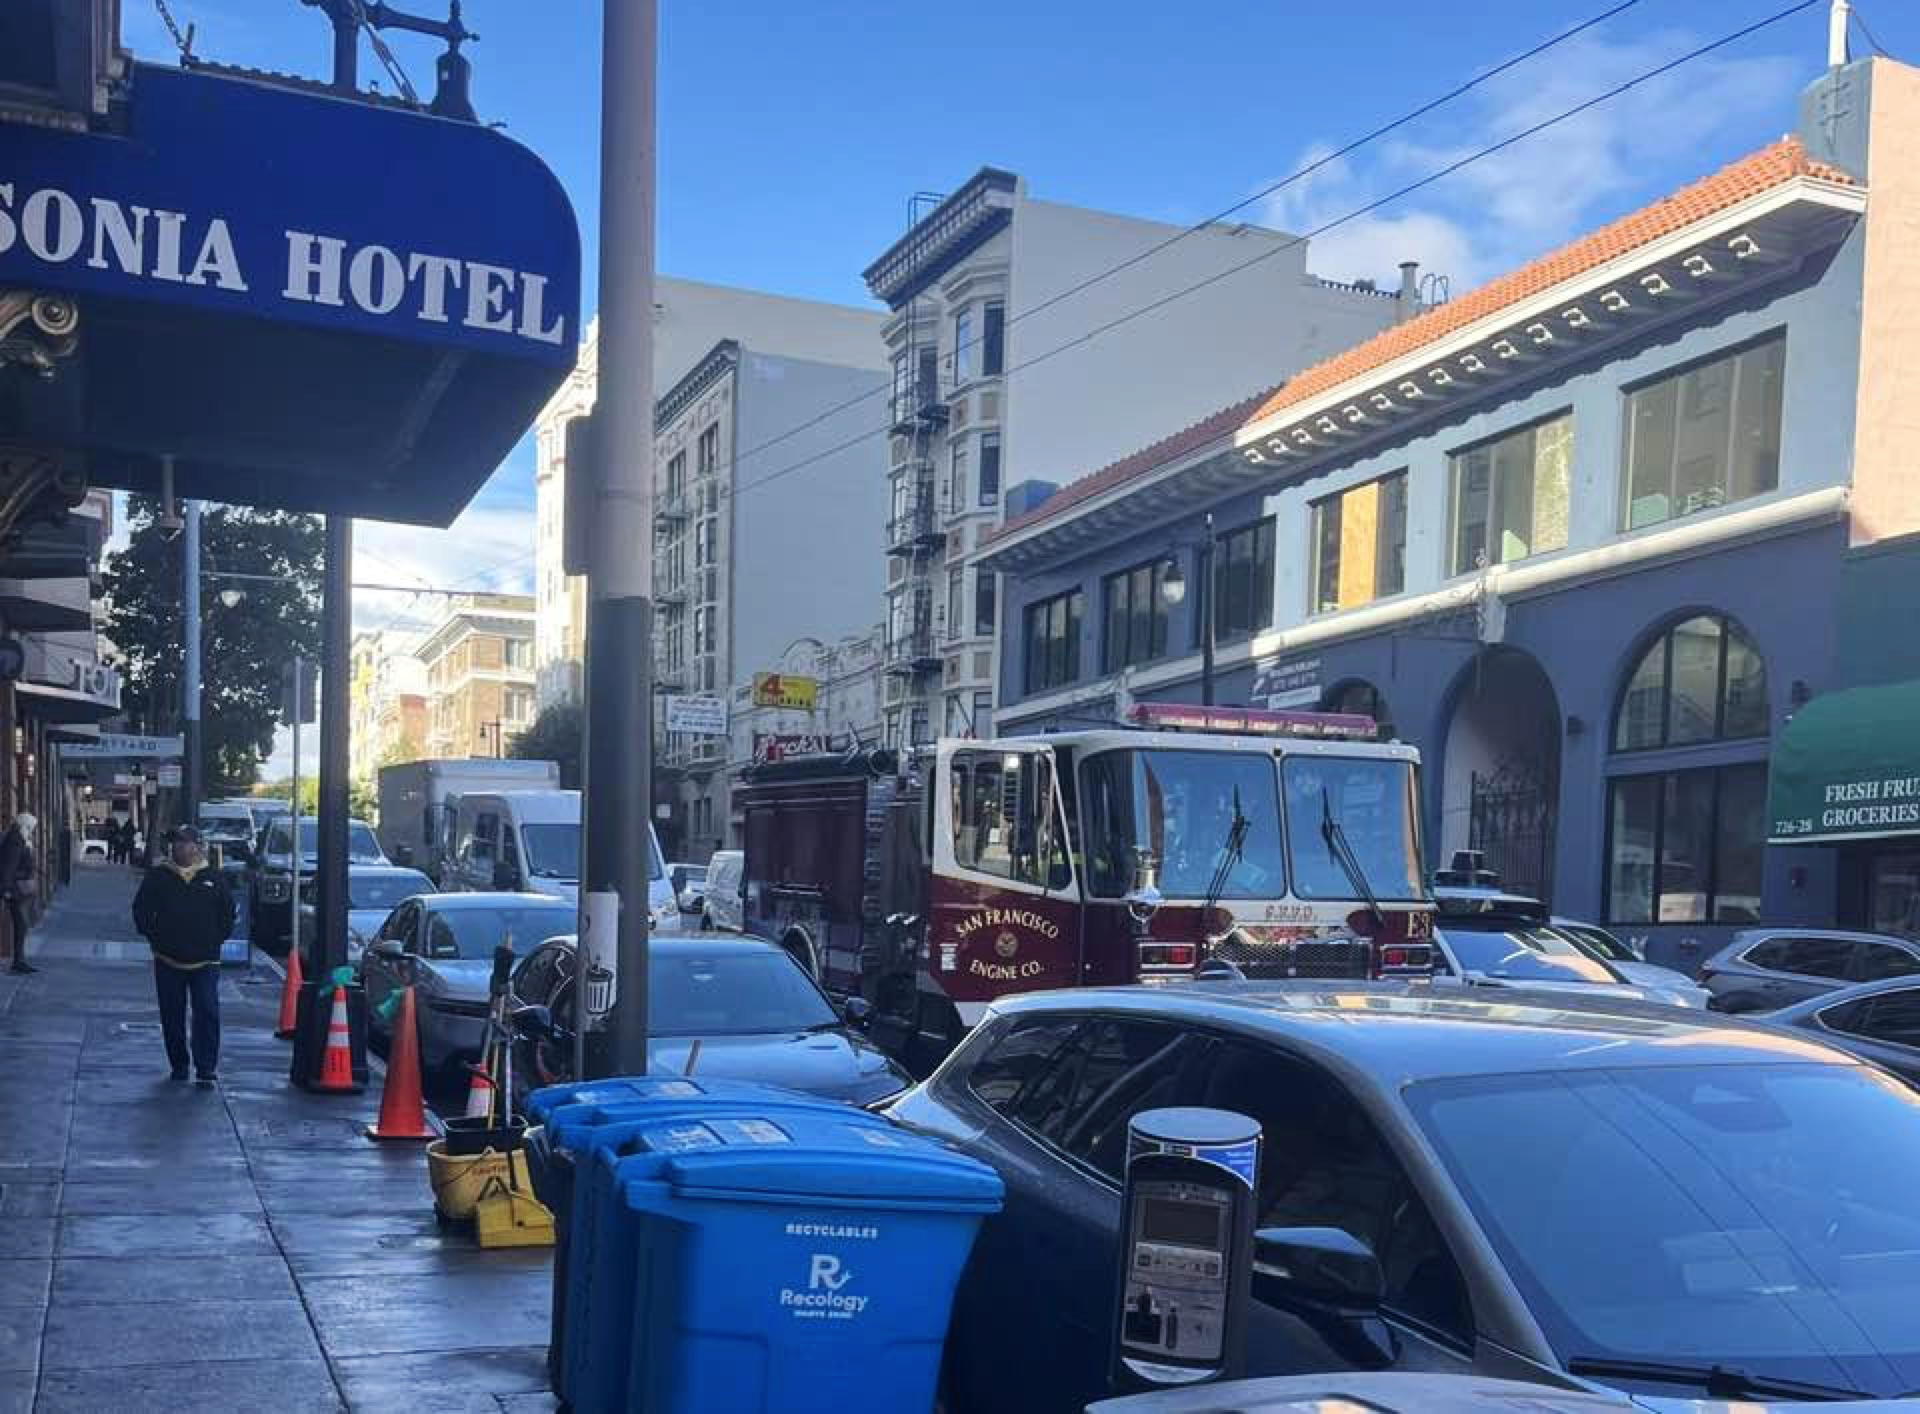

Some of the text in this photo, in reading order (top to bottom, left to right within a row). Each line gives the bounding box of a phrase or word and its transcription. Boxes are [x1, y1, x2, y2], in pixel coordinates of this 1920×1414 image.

[282, 230, 563, 345] HOTEL
[1825, 777, 1920, 802] FRESH FRU
[1822, 803, 1920, 826] GROCERIES
[956, 909, 1059, 939] SAN FRANCISCO
[970, 959, 1045, 979] ENGINE CO.
[785, 1223, 879, 1239] RECYCLABLES
[780, 1289, 868, 1312] Recology
